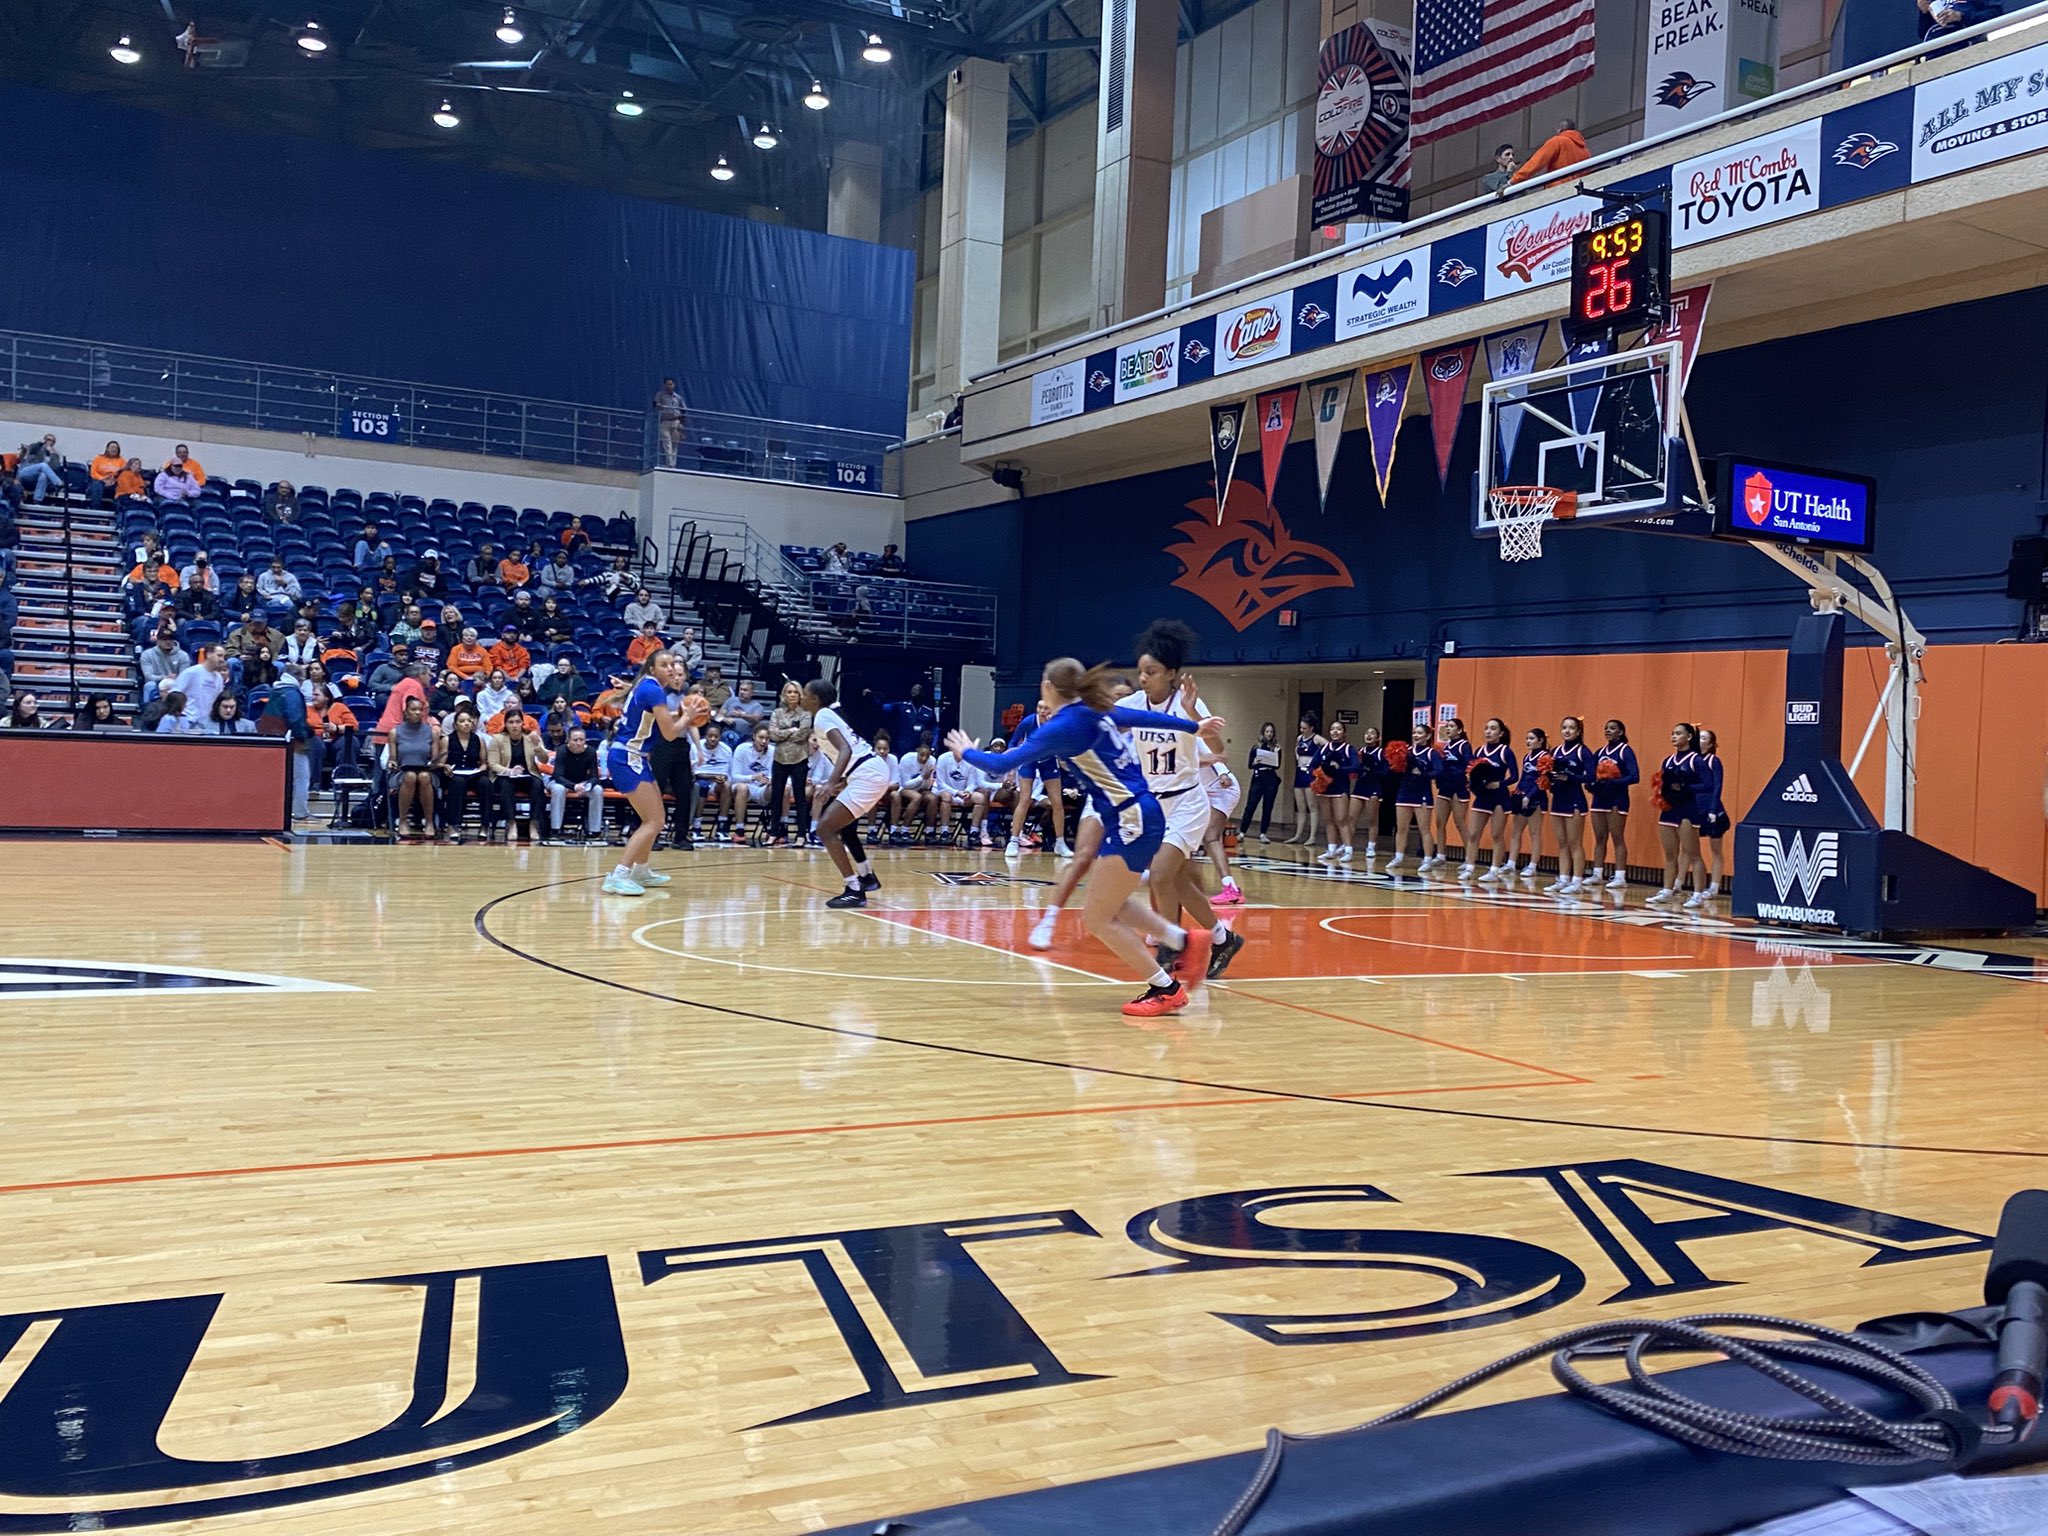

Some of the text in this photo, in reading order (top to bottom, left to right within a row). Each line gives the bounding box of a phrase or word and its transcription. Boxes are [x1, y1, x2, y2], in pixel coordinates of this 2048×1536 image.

[1661, 0, 1712, 28] BEAK
[1741, 0, 1778, 19] FREAK.
[1654, 12, 1723, 55] FREAK.
[1919, 69, 2048, 147] ALL MY S
[1936, 110, 2047, 152] MOVING & STOR
[1690, 148, 1797, 202] Red McCombs
[1678, 168, 1811, 230] TOYOTA
[1511, 211, 1590, 257] Cowboys
[1592, 221, 1643, 259] 9:53
[1585, 259, 1632, 318] 26
[1346, 300, 1417, 327] STRATEGIC WEALTH
[1120, 342, 1175, 382] BEATBOX
[352, 410, 389, 421] SECTION
[352, 418, 388, 436] 103
[837, 462, 867, 470] SECTION
[837, 468, 866, 484] 104
[1773, 489, 1852, 521] UT Health
[1634, 518, 1674, 526] sa.com
[1773, 515, 1821, 532] San Antonio
[1788, 712, 1817, 722] LIGHT
[1792, 704, 1814, 713] BUD
[1139, 731, 1177, 744] UTSA
[1147, 747, 1177, 775] 11
[1782, 791, 1818, 803] adidas
[1757, 903, 1838, 925] WHATABURGER
[0, 1159, 1996, 1534] UTSA
